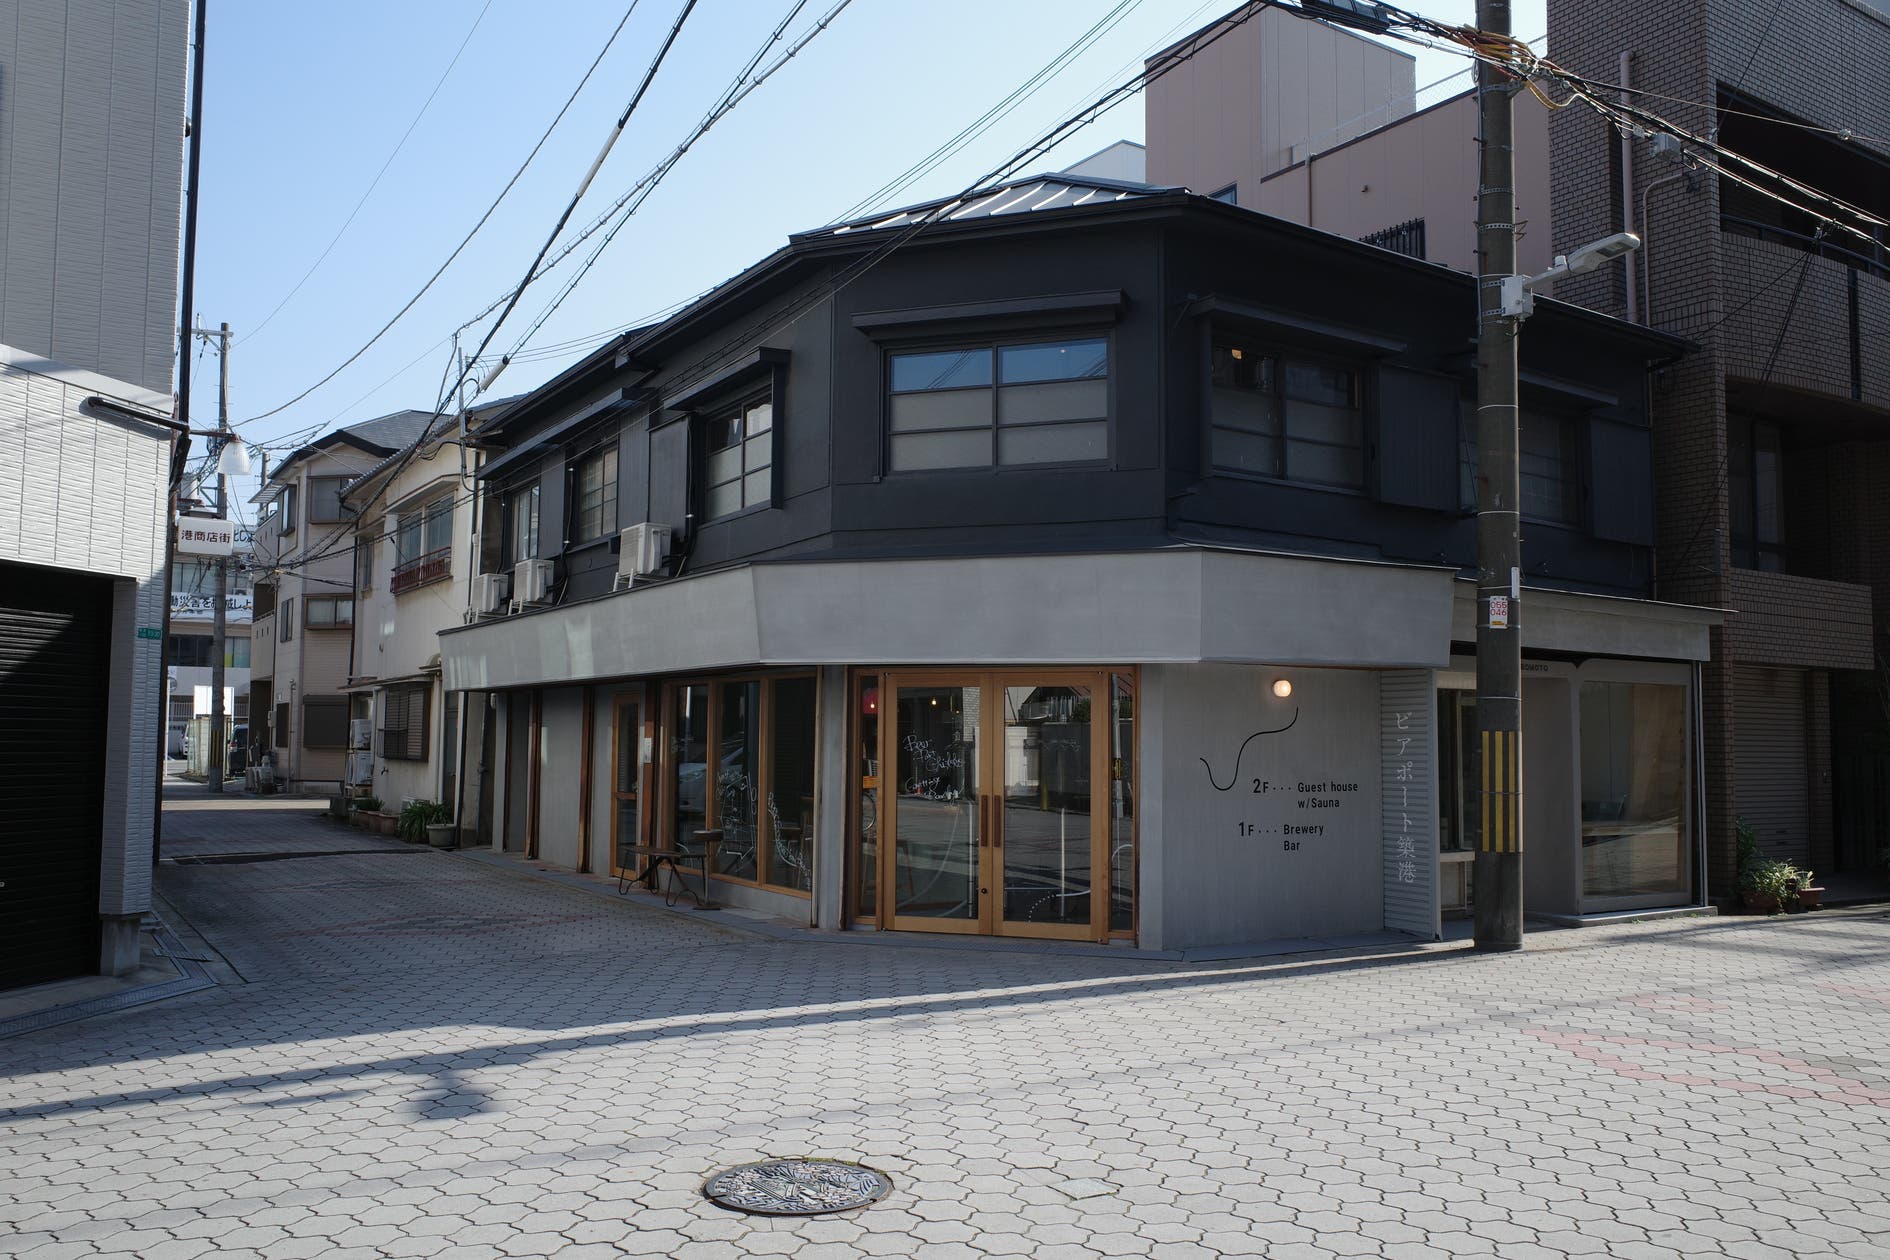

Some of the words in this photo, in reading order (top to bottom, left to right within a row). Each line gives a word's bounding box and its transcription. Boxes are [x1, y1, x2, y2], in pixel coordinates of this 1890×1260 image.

[181, 530, 231, 543] 港商店街
[1297, 782, 1326, 793] Guest
[1330, 781, 1358, 792] house
[1297, 798, 1340, 809] w/Sauna
[1396, 712, 1416, 883] ビアポート築港
[1283, 824, 1324, 836] Brewery
[1283, 840, 1300, 851] Bar
